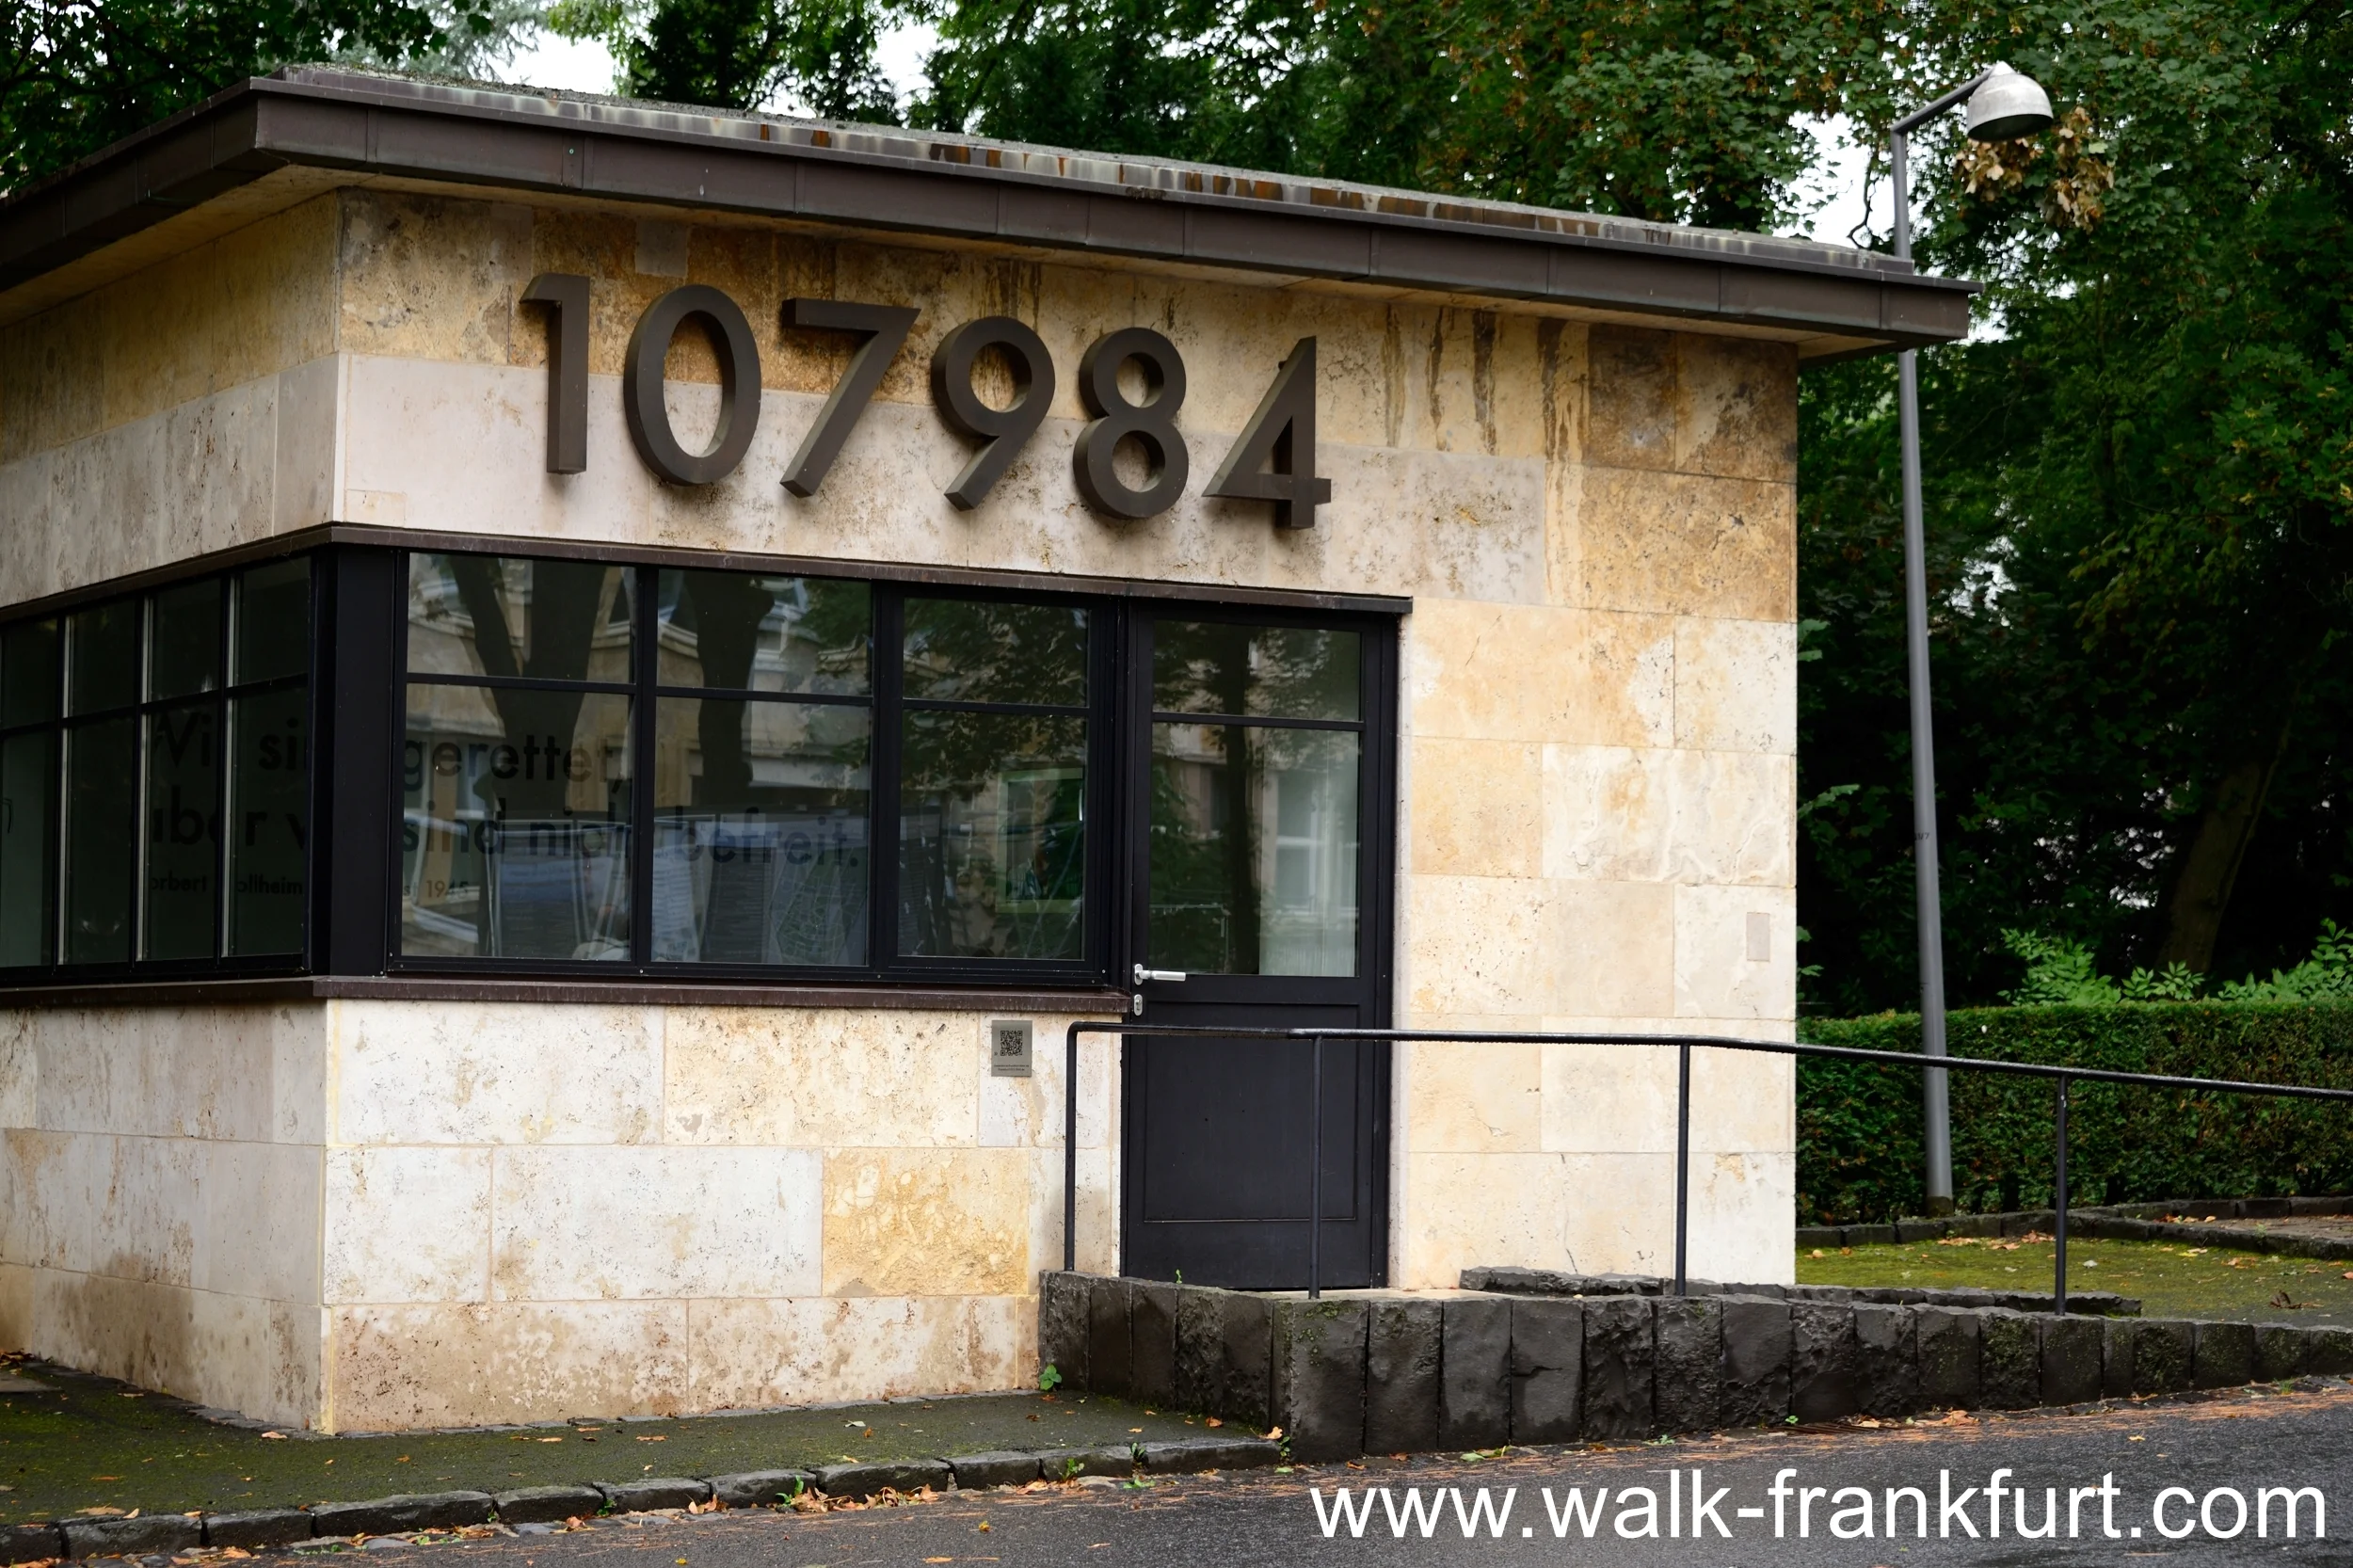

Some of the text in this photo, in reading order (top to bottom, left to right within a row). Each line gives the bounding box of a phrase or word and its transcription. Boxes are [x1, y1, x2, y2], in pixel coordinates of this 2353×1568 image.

[519, 272, 1332, 530] 107984
[529, 801, 633, 859] nich
[675, 806, 859, 868] befreit.
[150, 870, 208, 892] orbert
[236, 872, 303, 895] ollheim
